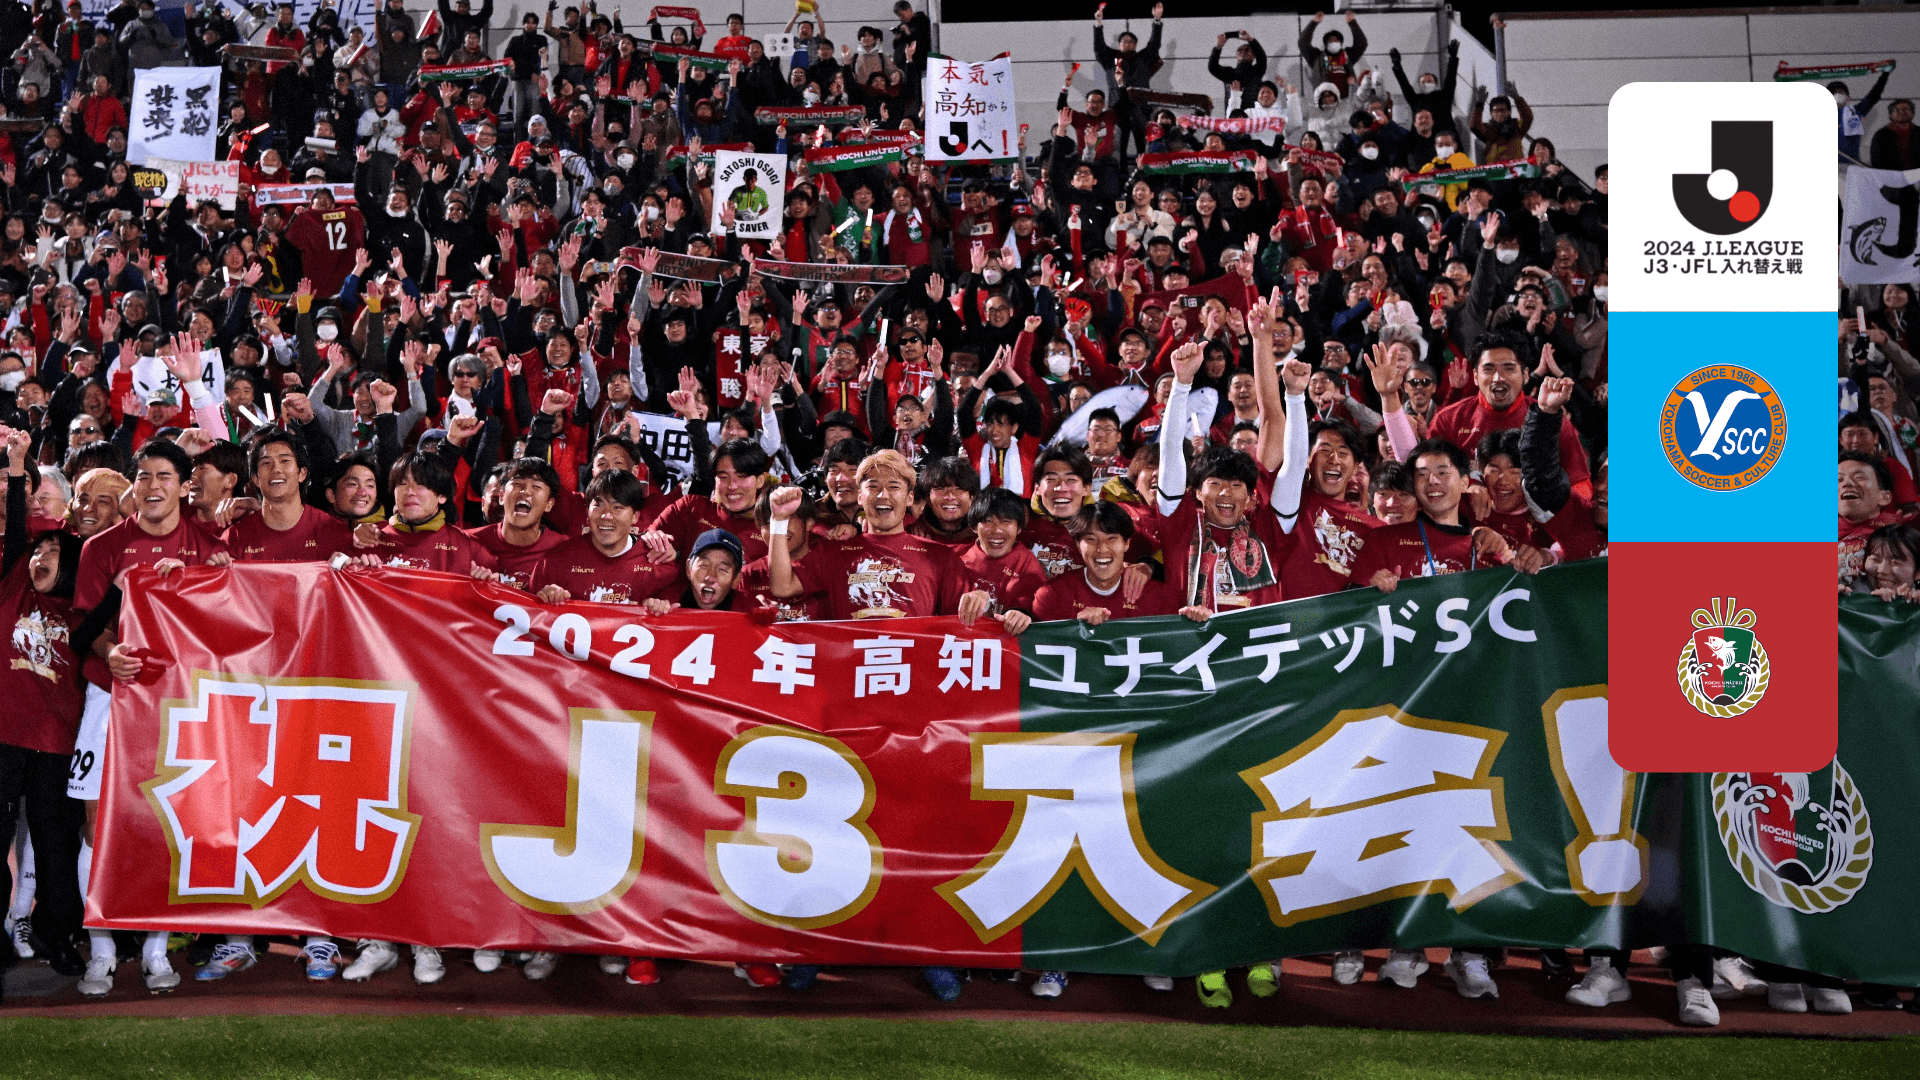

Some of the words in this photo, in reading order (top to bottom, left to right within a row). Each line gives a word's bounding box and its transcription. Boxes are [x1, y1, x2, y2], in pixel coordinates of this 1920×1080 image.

[939, 60, 1005, 86] 本気で
[935, 87, 1008, 117] 高知から
[808, 111, 844, 119] UNITED
[938, 121, 1009, 157] Jへ!
[836, 152, 864, 161] KOCHI
[865, 145, 901, 157] UNITED
[1171, 157, 1197, 165] KOCHI
[1199, 156, 1229, 164] UNITED
[720, 157, 755, 182] SATOSHI
[756, 159, 780, 186] OSUGI
[325, 221, 348, 250] 12
[739, 221, 769, 232] SAVER
[720, 377, 742, 399] 聡
[601, 593, 627, 601] 2024
[148, 674, 416, 903] 祝
[1760, 823, 1792, 839] KOCHI
[1792, 831, 1825, 850] UNITED
[1774, 835, 1799, 848] SPORTS
